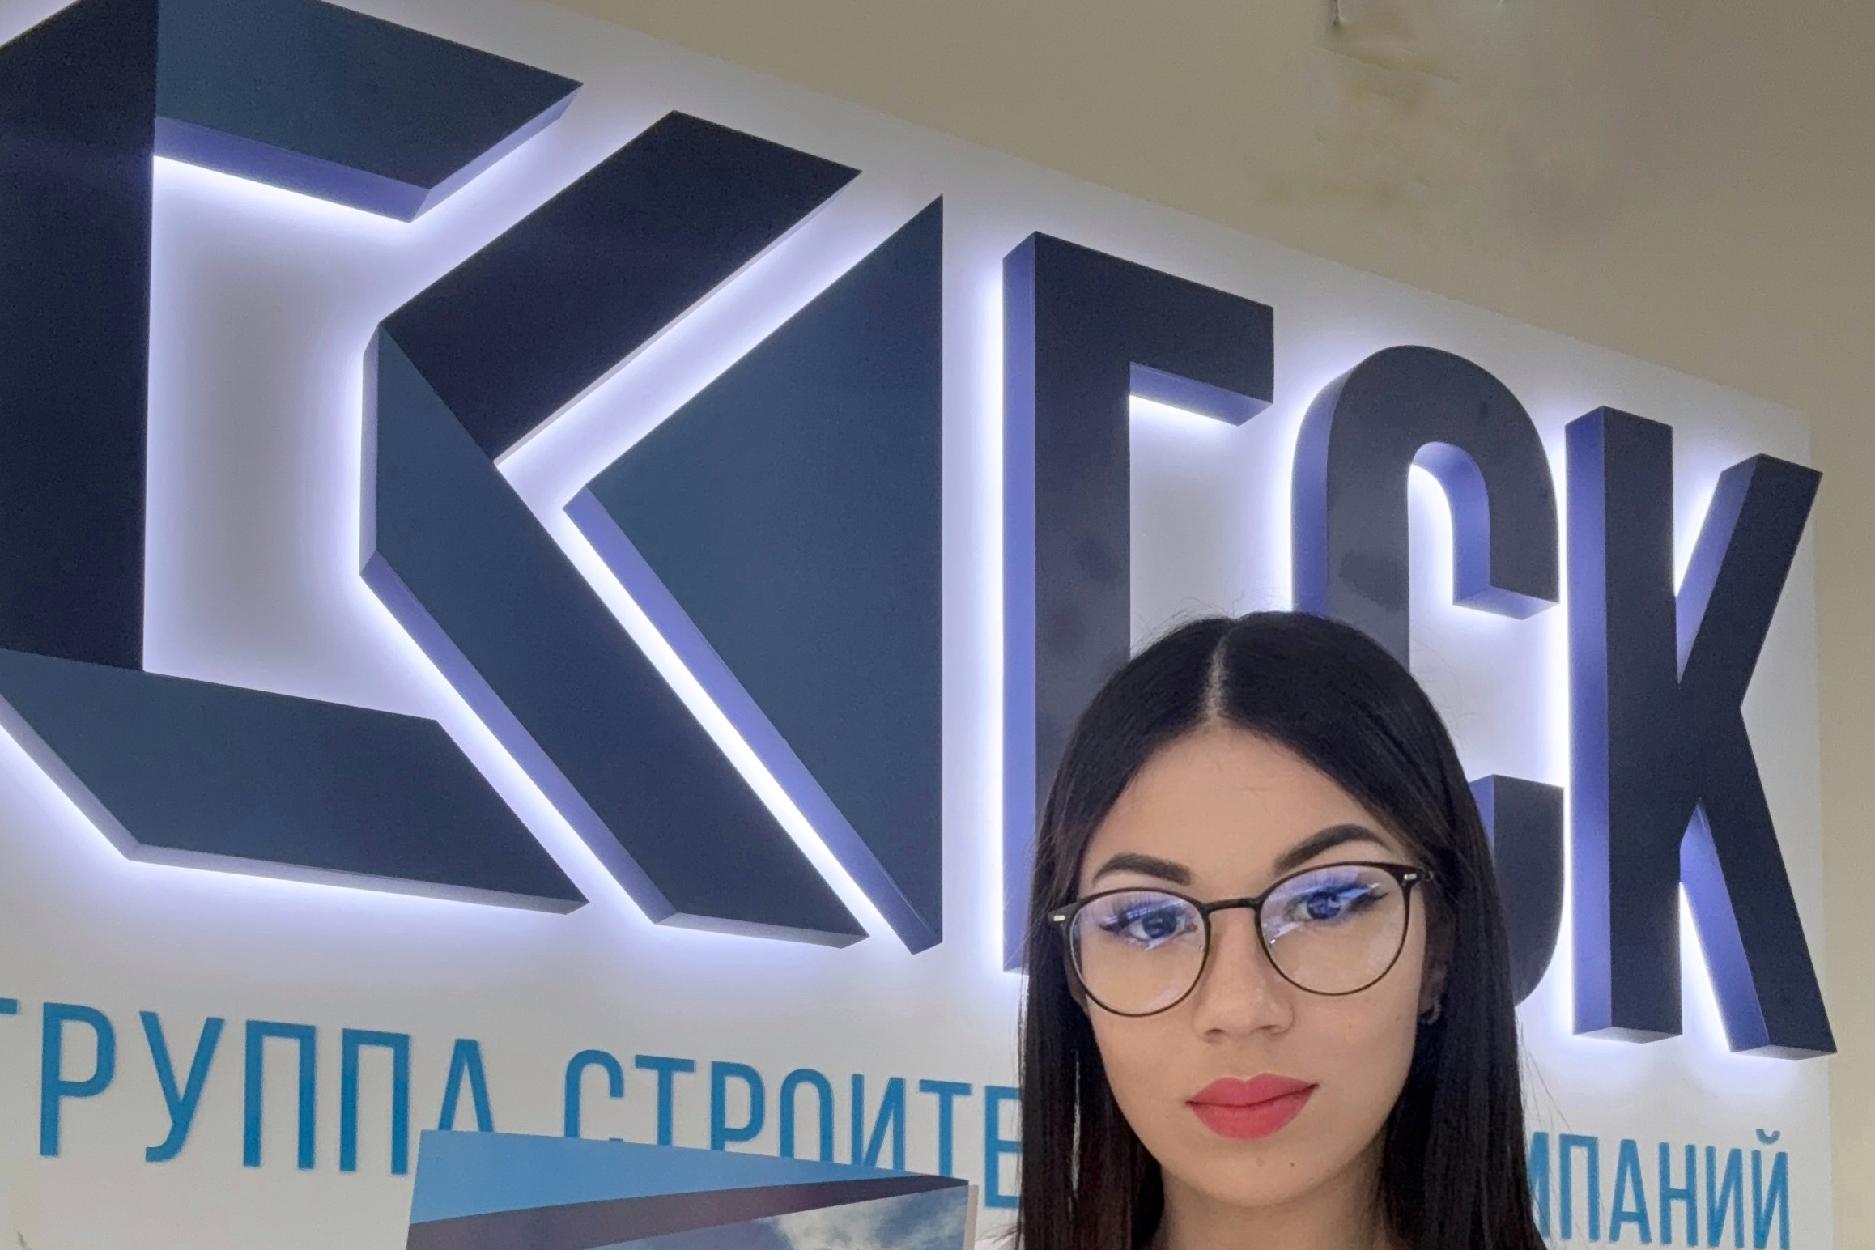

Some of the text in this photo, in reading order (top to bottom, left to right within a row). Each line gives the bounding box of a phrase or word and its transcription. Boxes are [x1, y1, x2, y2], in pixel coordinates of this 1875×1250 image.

[1003, 231, 1837, 1060] ГСК
[0, 997, 495, 1175] РУППА
[564, 1049, 1024, 1208] СТРОИТЕ
